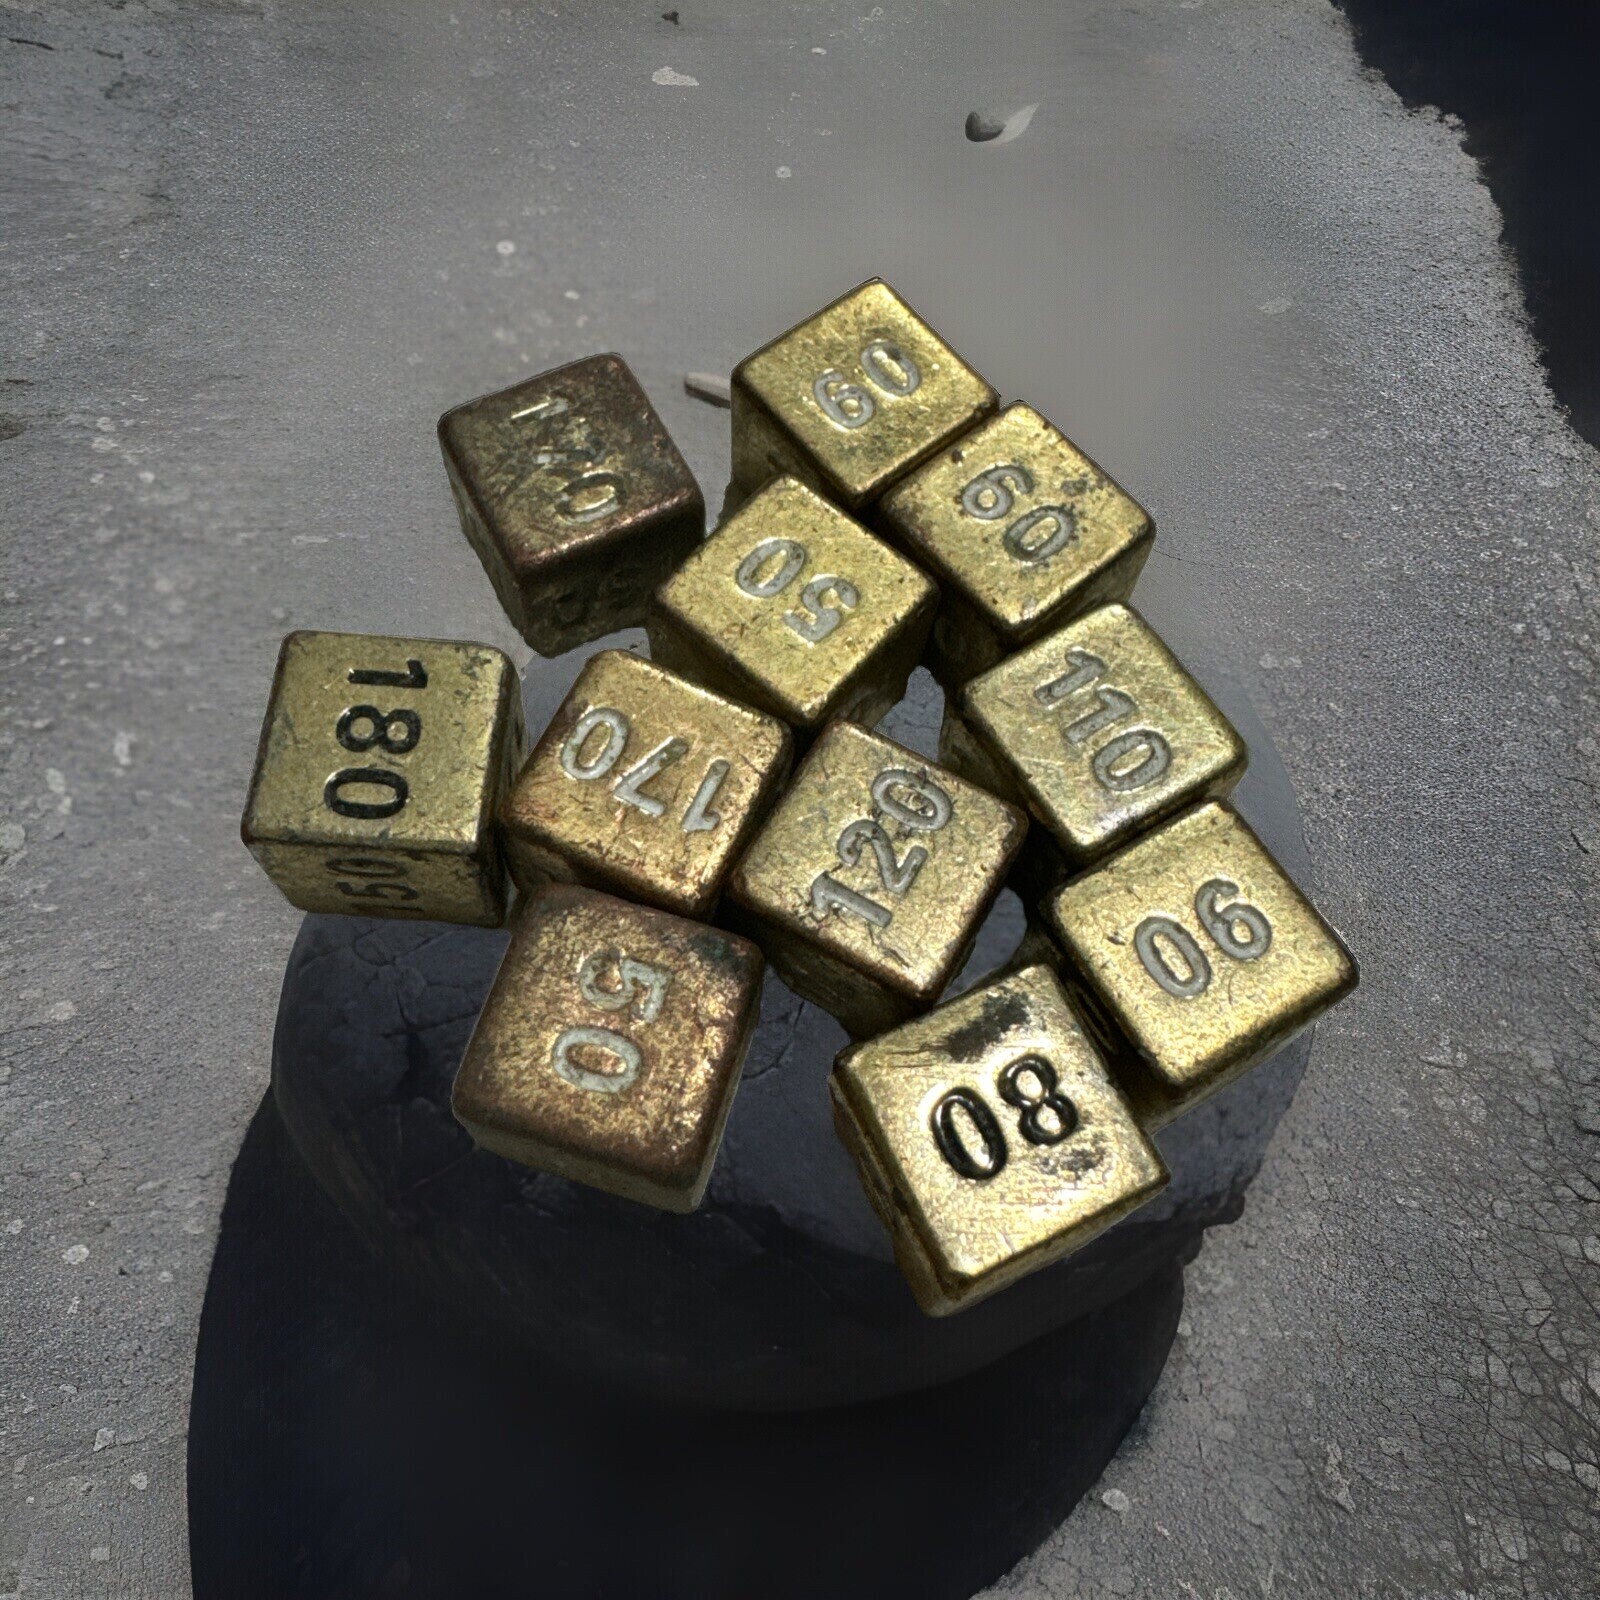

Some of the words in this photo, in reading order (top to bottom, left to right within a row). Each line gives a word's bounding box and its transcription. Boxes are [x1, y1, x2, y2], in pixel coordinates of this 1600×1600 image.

[323, 658, 428, 820] 180
[560, 707, 731, 833] 170
[1033, 648, 1172, 792] 110
[811, 768, 953, 929] 120
